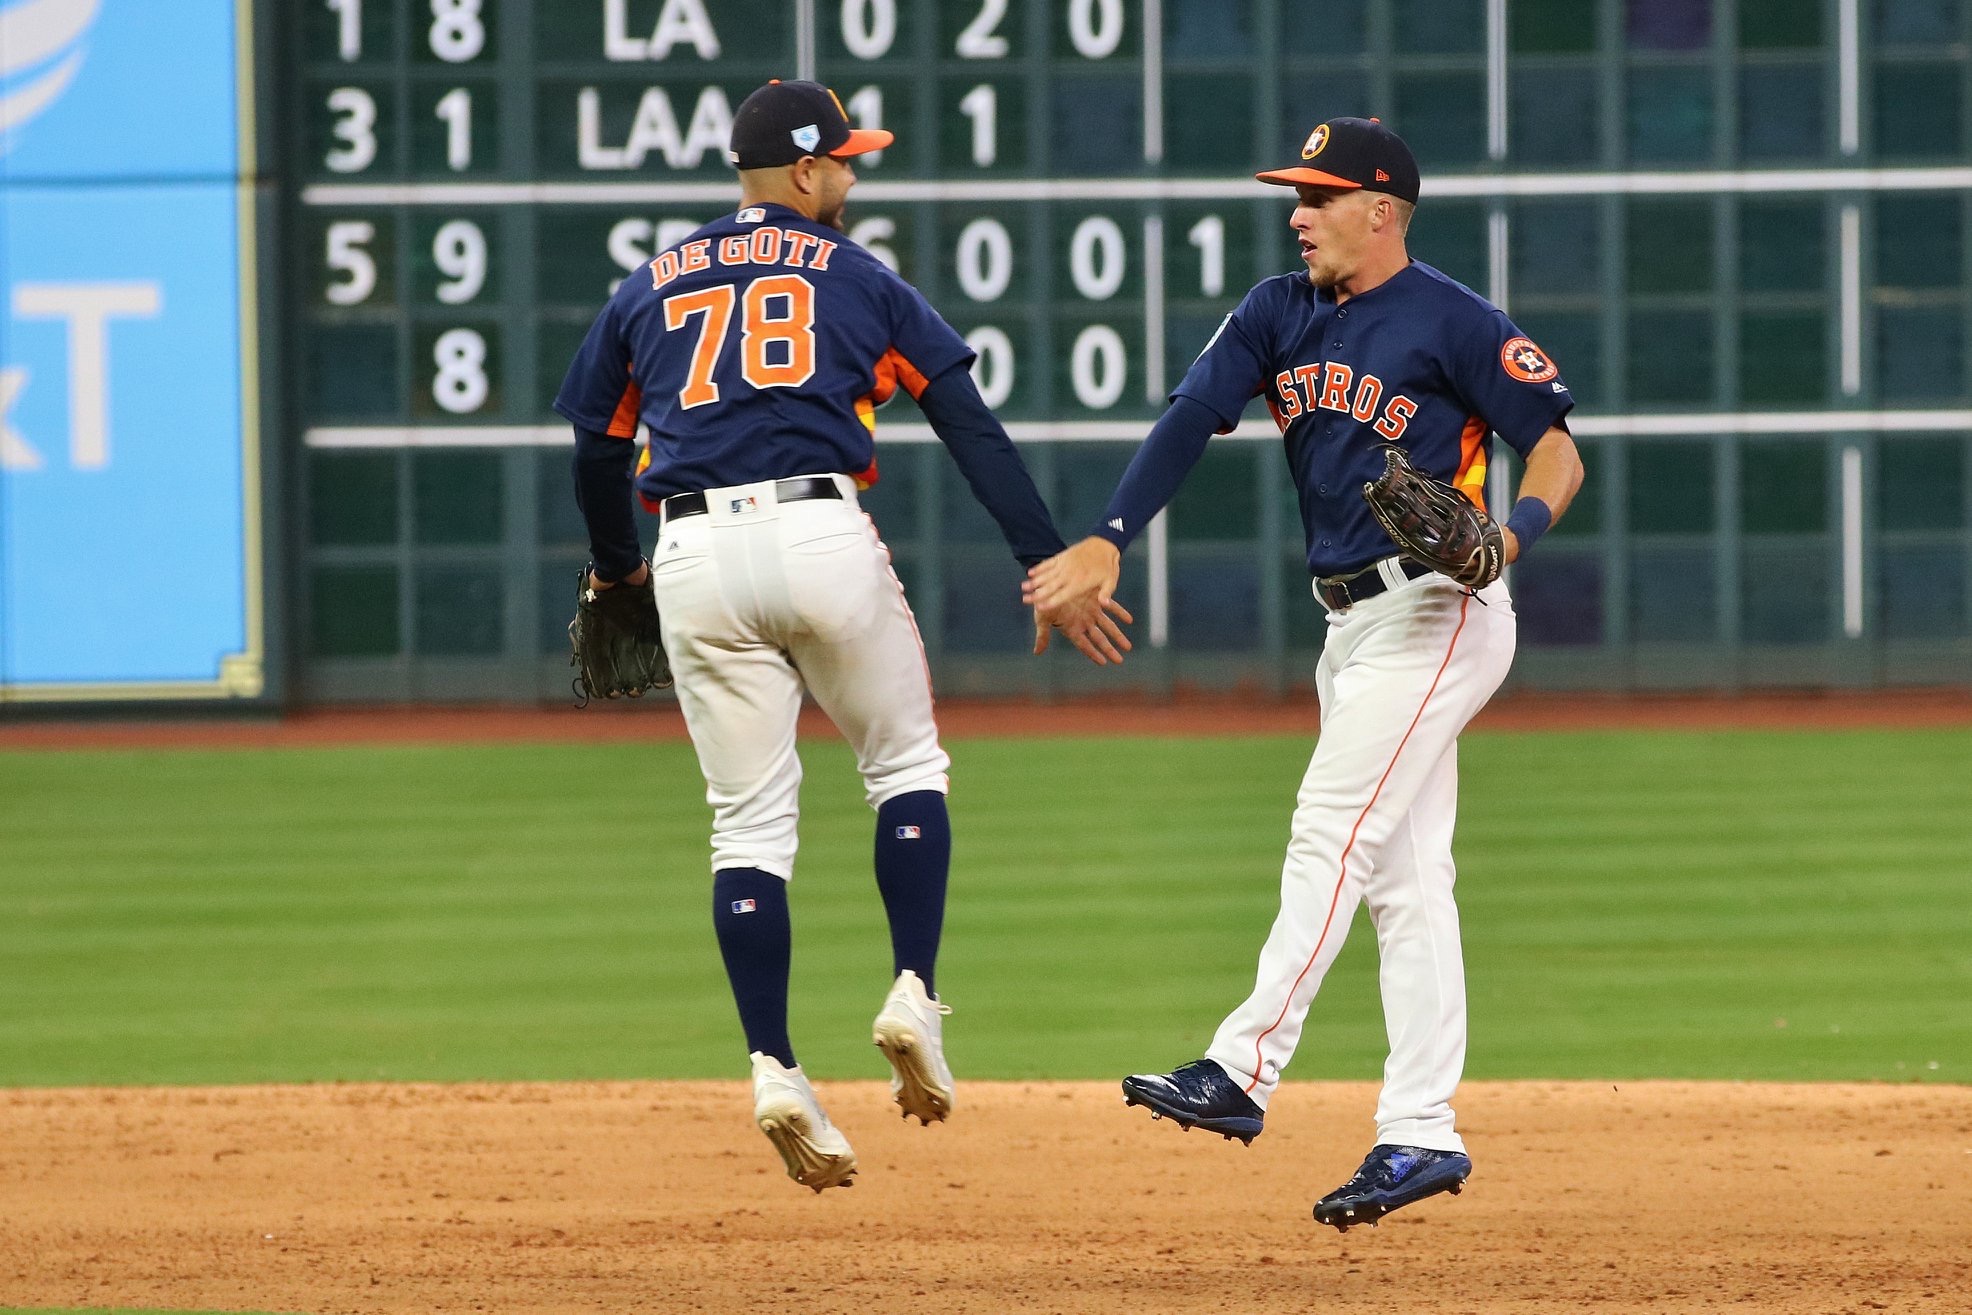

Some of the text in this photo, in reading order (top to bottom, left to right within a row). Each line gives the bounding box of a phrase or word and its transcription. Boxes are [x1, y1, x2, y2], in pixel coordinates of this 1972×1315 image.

[327, 0, 1124, 63] 1 8 LA 0 2 0
[325, 84, 997, 173] 3 1 LAA 1 1
[326, 220, 377, 304] 5
[433, 219, 488, 304] 9
[956, 218, 1012, 301] 0
[1070, 215, 1126, 300] 0
[1188, 216, 1224, 297] 1
[649, 226, 838, 291] DE GOTI
[433, 324, 1127, 413] 8 0 0
[663, 273, 816, 411] 78
